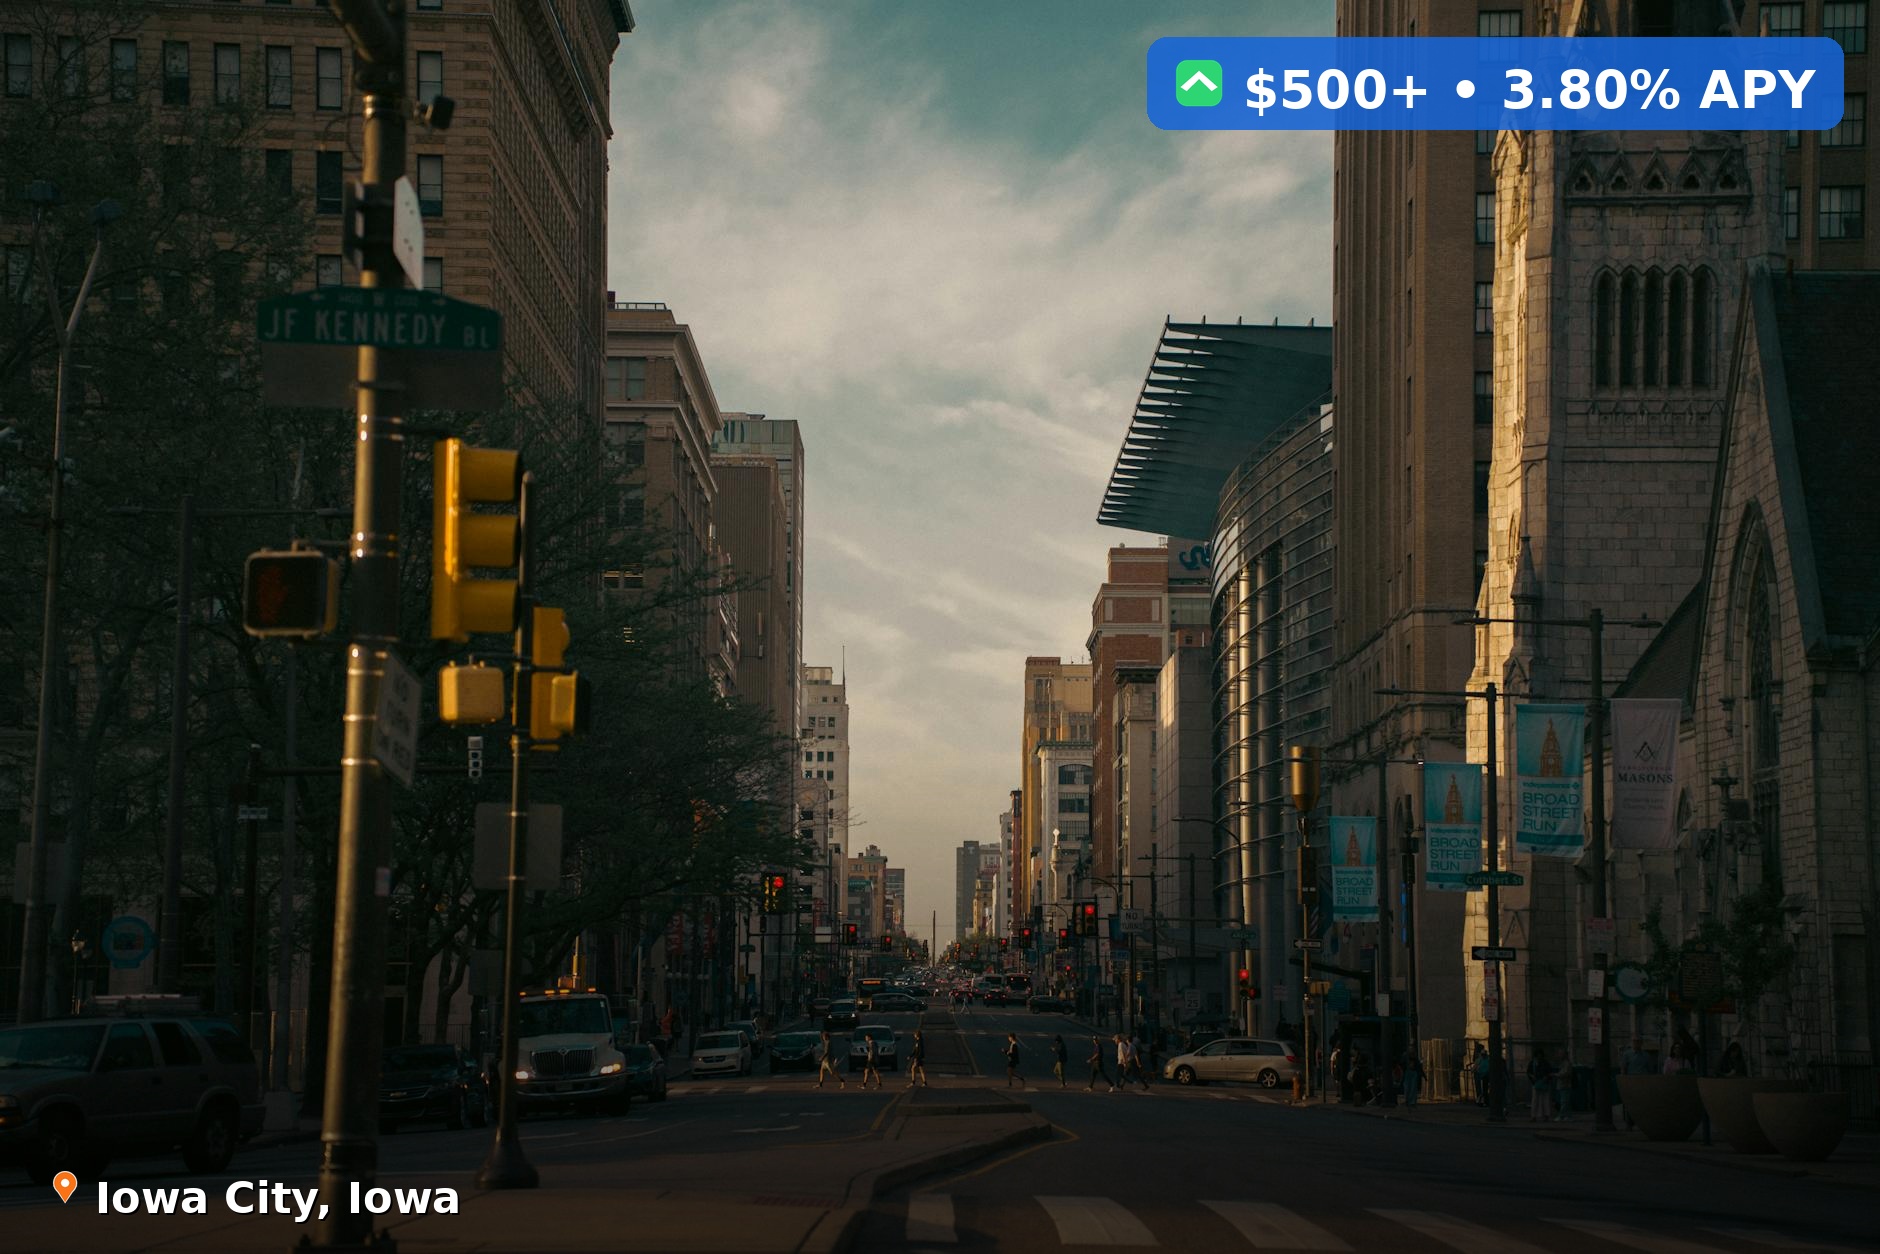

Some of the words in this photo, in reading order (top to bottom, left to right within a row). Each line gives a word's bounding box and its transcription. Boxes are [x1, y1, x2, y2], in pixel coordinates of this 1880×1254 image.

[265, 308, 299, 339] JF
[314, 309, 447, 345] KENNEDY
[463, 325, 491, 349] BL
[1616, 773, 1673, 784] MASONS
[1522, 791, 1580, 805] BROAD
[1522, 805, 1579, 819] STREET
[1523, 818, 1557, 832] RUN
[1430, 837, 1479, 848] BROAD
[1430, 848, 1480, 860] STREET
[1431, 860, 1460, 872] RUN
[1336, 877, 1373, 886] BROAD
[1466, 875, 1509, 885] Cuthbert
[1336, 887, 1374, 896] STREET
[1336, 896, 1360, 904] RUN
[1125, 912, 1138, 920] NO
[1187, 1000, 1198, 1008] 25
